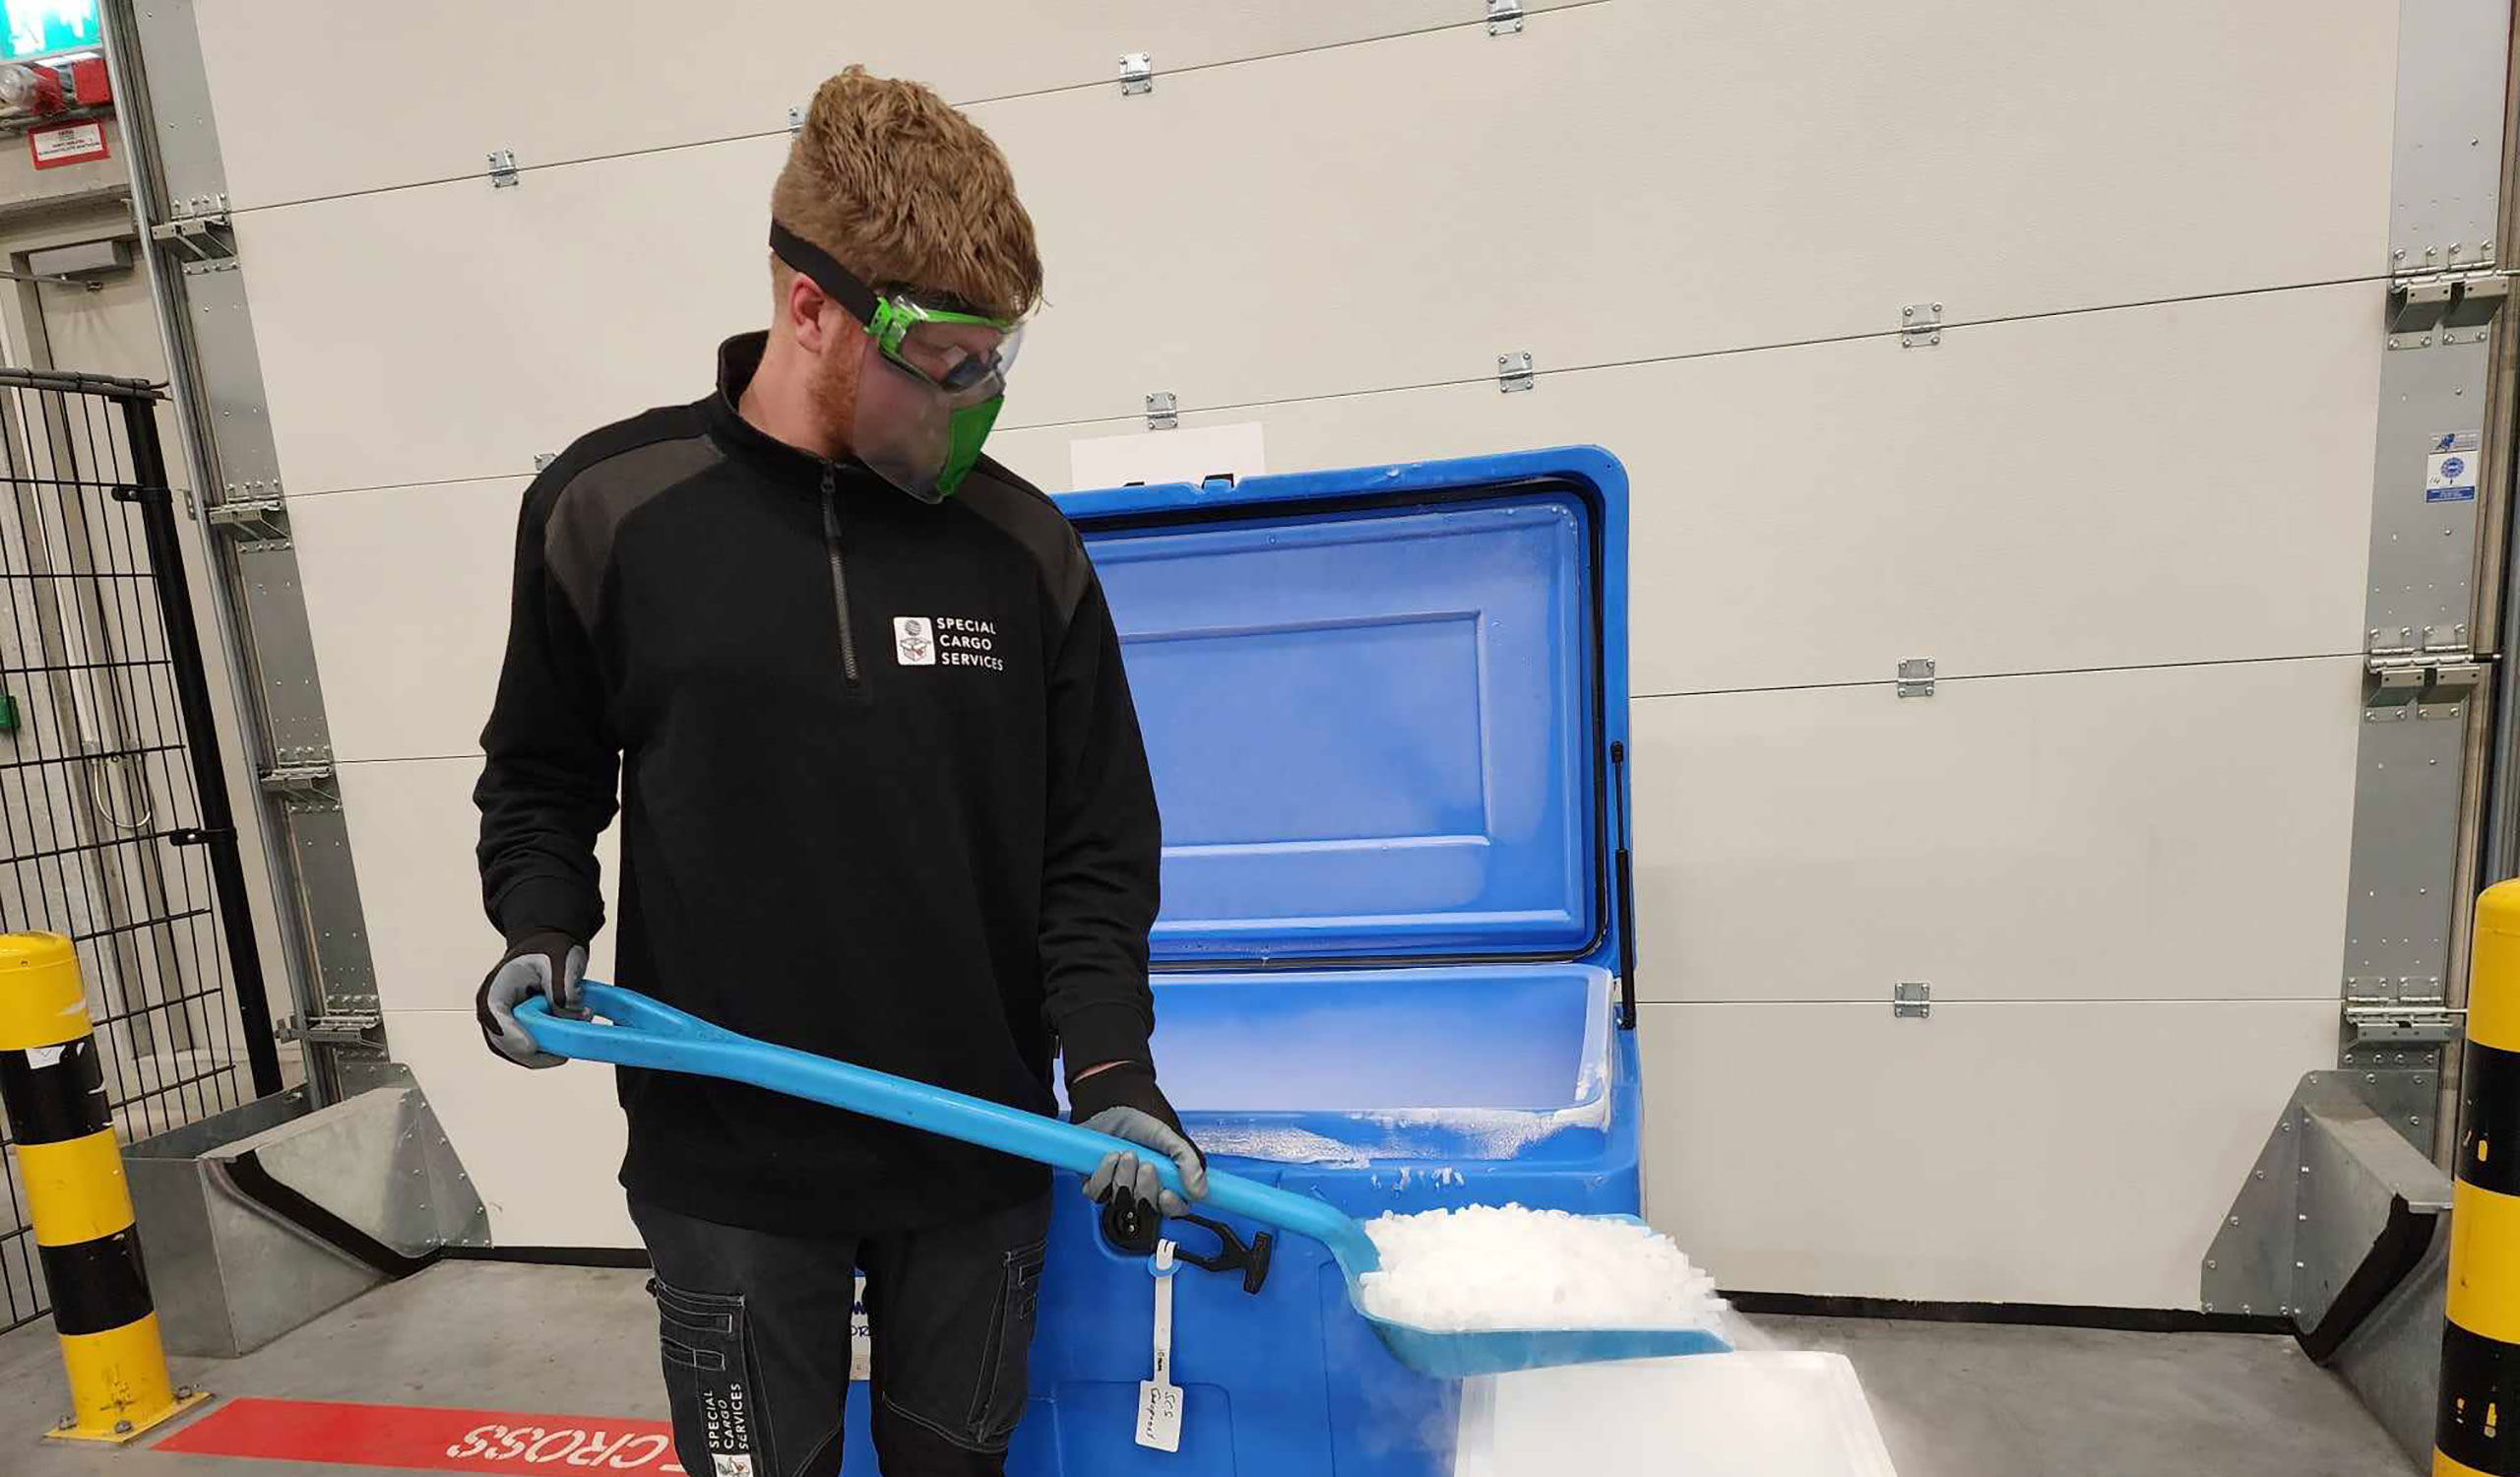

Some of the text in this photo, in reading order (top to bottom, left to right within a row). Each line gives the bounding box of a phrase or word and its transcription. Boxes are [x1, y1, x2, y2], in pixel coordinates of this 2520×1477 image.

[936, 616, 997, 635] SPECIAL
[939, 634, 992, 651] CARGO
[941, 652, 1004, 672] SERVICES
[704, 1390, 720, 1448] SPECIAL
[717, 1399, 734, 1449] CARGO
[729, 1382, 750, 1449] SERVICES
[446, 1425, 668, 1468] CROSS
